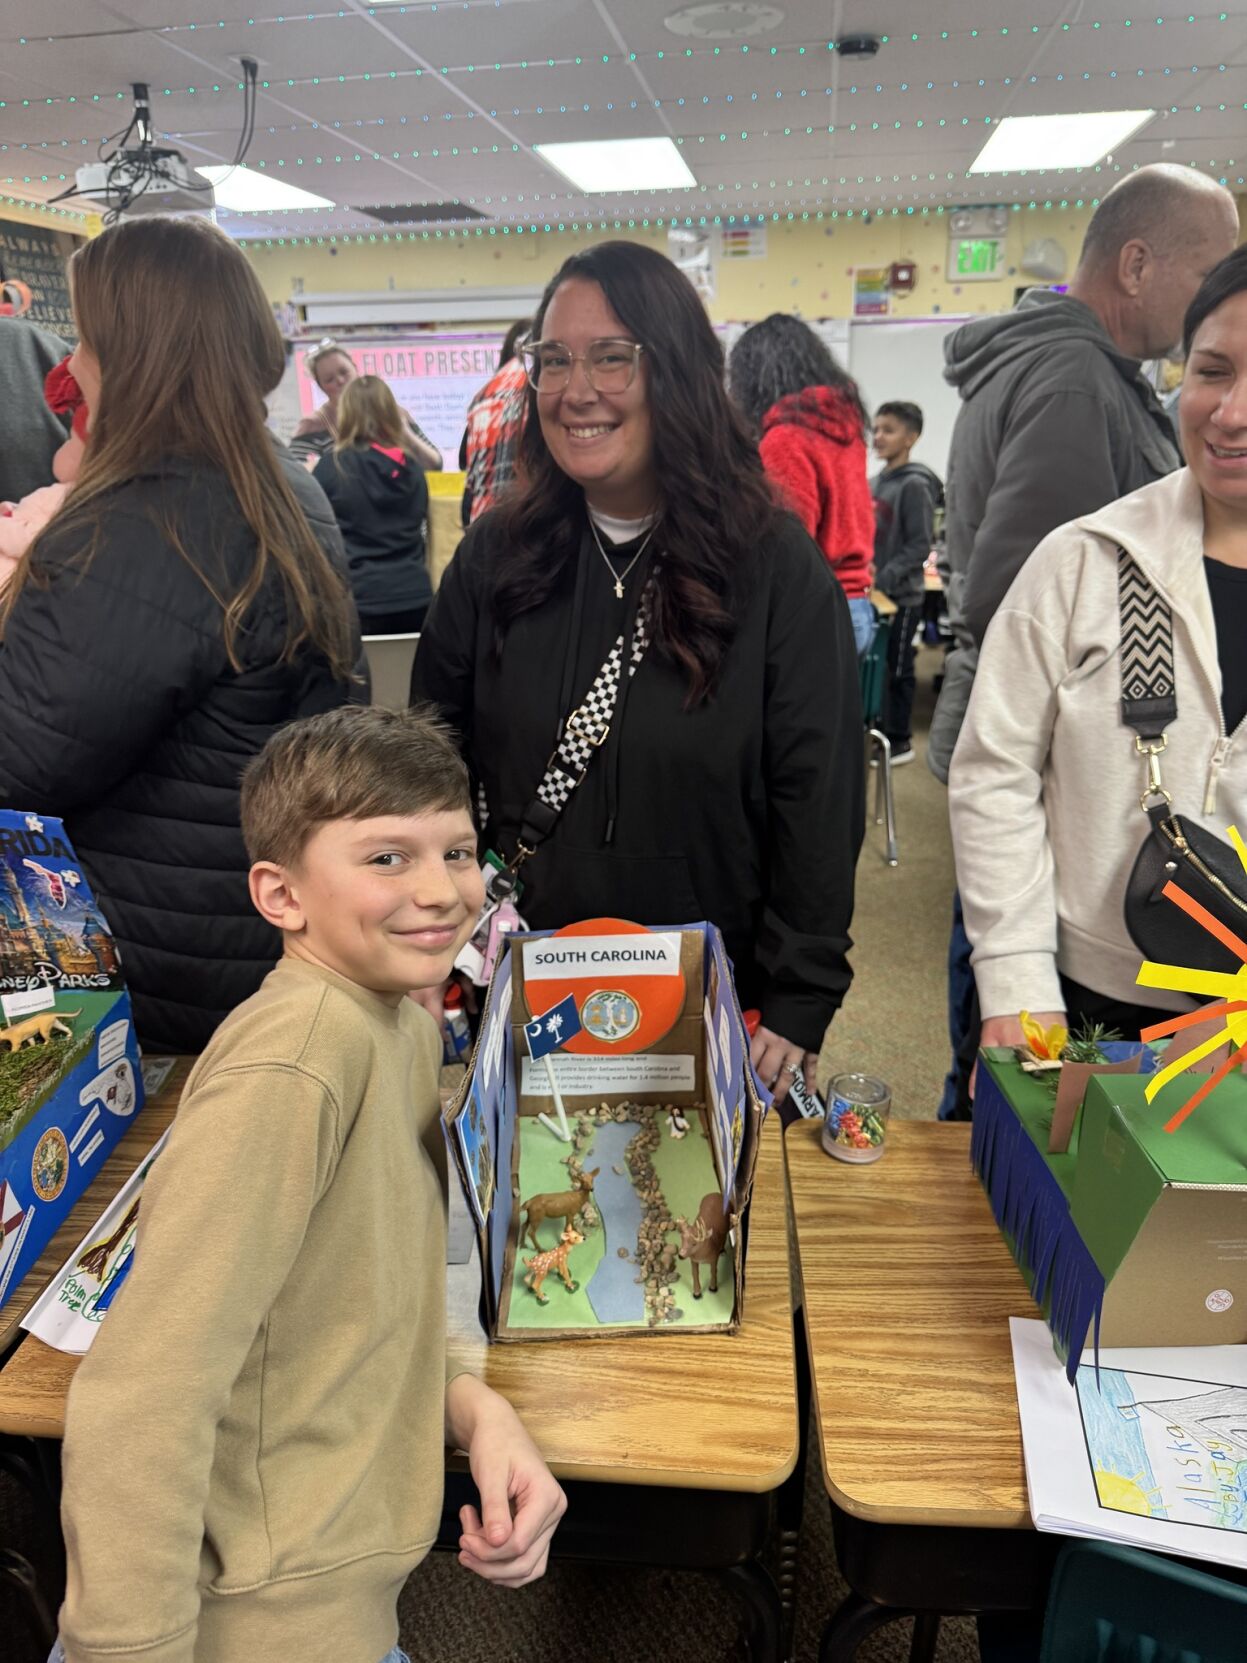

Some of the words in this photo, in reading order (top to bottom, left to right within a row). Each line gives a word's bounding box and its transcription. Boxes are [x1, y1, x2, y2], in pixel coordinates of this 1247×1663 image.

[362, 351, 416, 377] FLOAT
[535, 951, 586, 965] SOUTH
[591, 949, 667, 962] CAROLINA
[64, 1278, 87, 1302] Palm
[1165, 1424, 1234, 1519] Alaska
